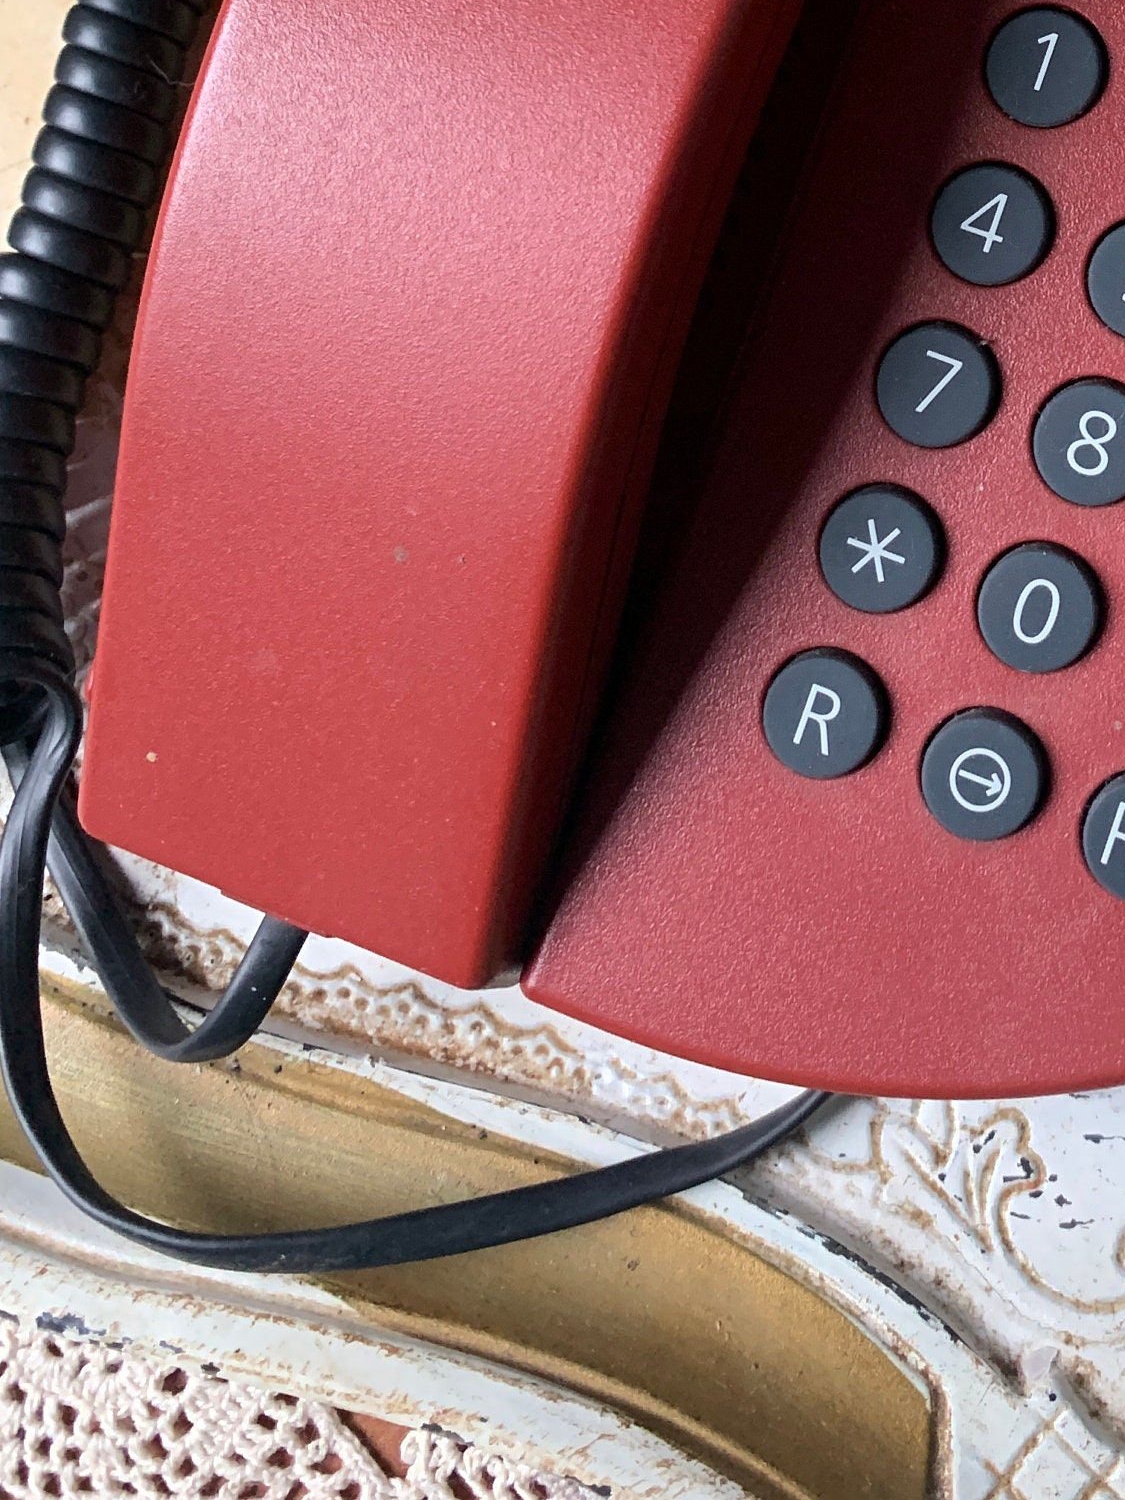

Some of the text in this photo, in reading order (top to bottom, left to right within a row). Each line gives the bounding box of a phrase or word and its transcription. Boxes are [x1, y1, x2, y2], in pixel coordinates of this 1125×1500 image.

[1033, 32, 1059, 91] 1
[960, 193, 1008, 253] 4
[914, 349, 963, 414] 7
[1066, 410, 1117, 477] 8
[1012, 578, 1060, 645] 0
[792, 683, 841, 756] R
